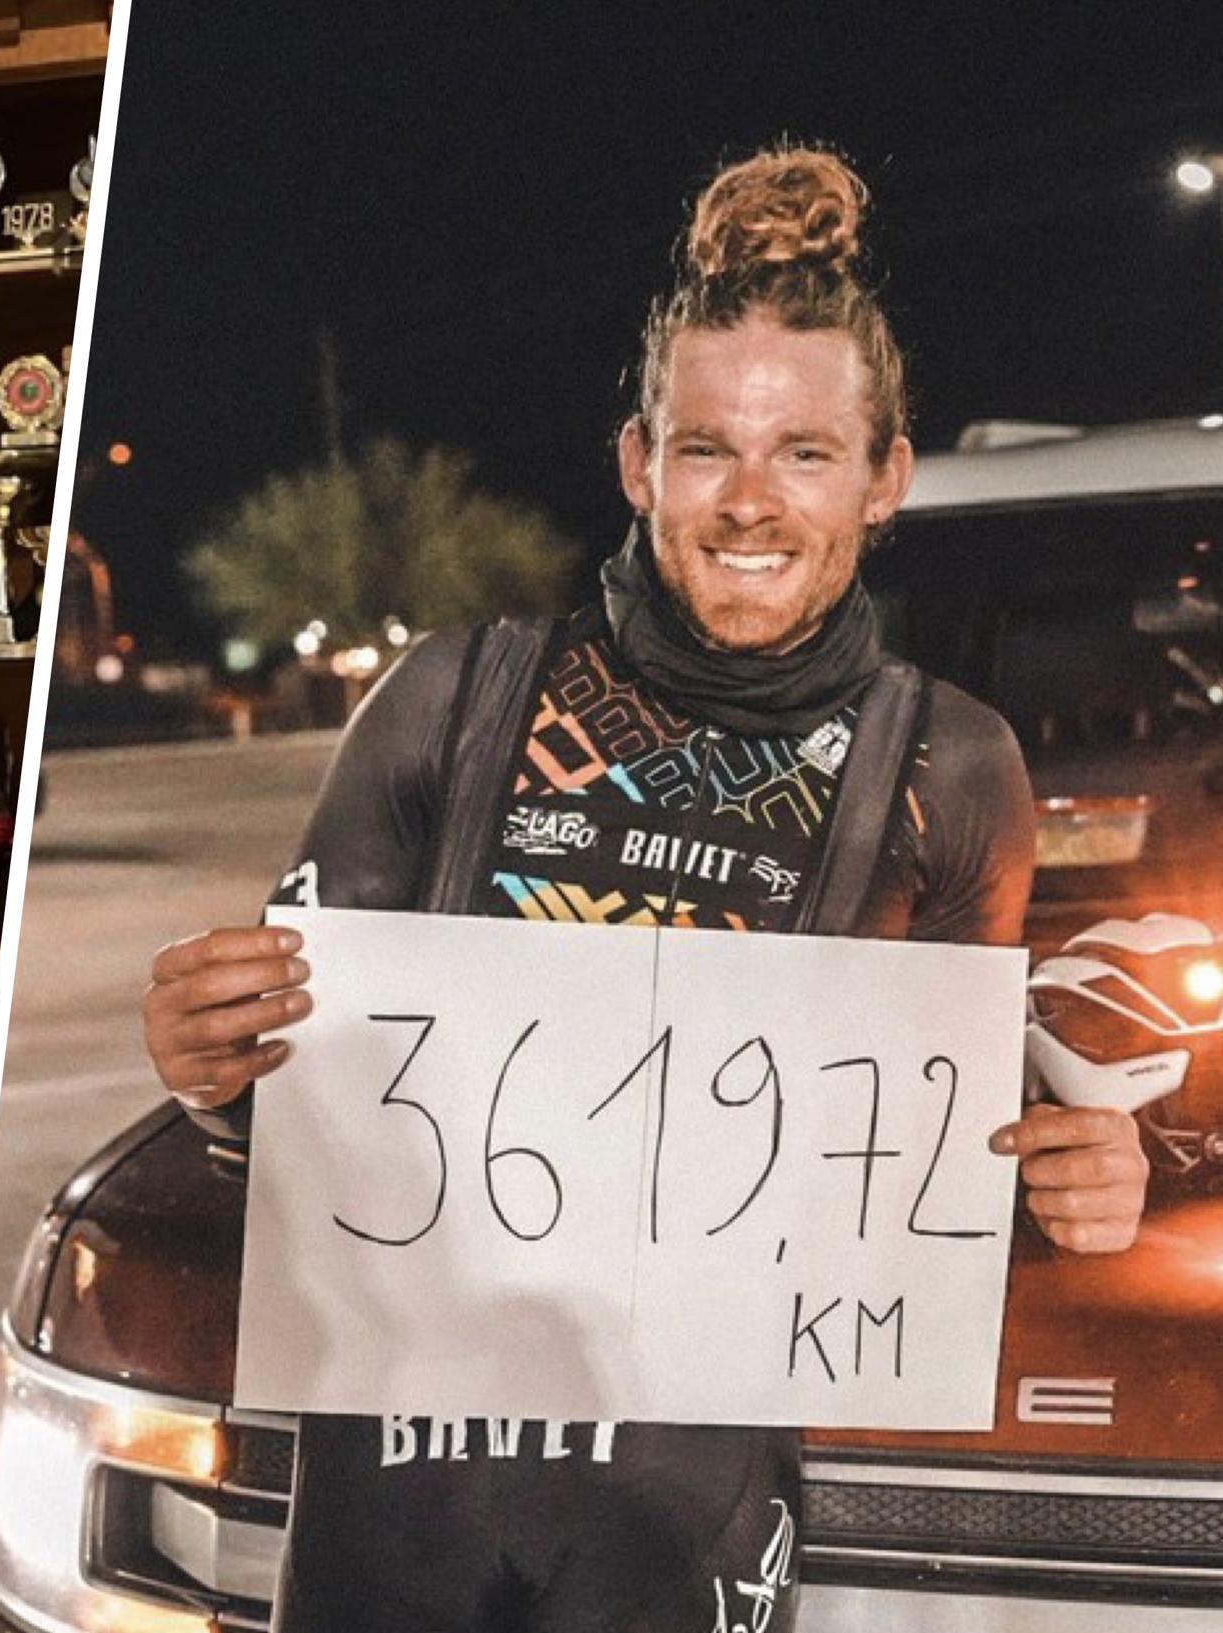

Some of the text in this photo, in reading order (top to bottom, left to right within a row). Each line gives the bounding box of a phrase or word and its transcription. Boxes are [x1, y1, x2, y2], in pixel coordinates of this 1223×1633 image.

[1, 203, 55, 236] 1978
[332, 1012, 999, 1265] 3619,72
[786, 1292, 906, 1383] KM
